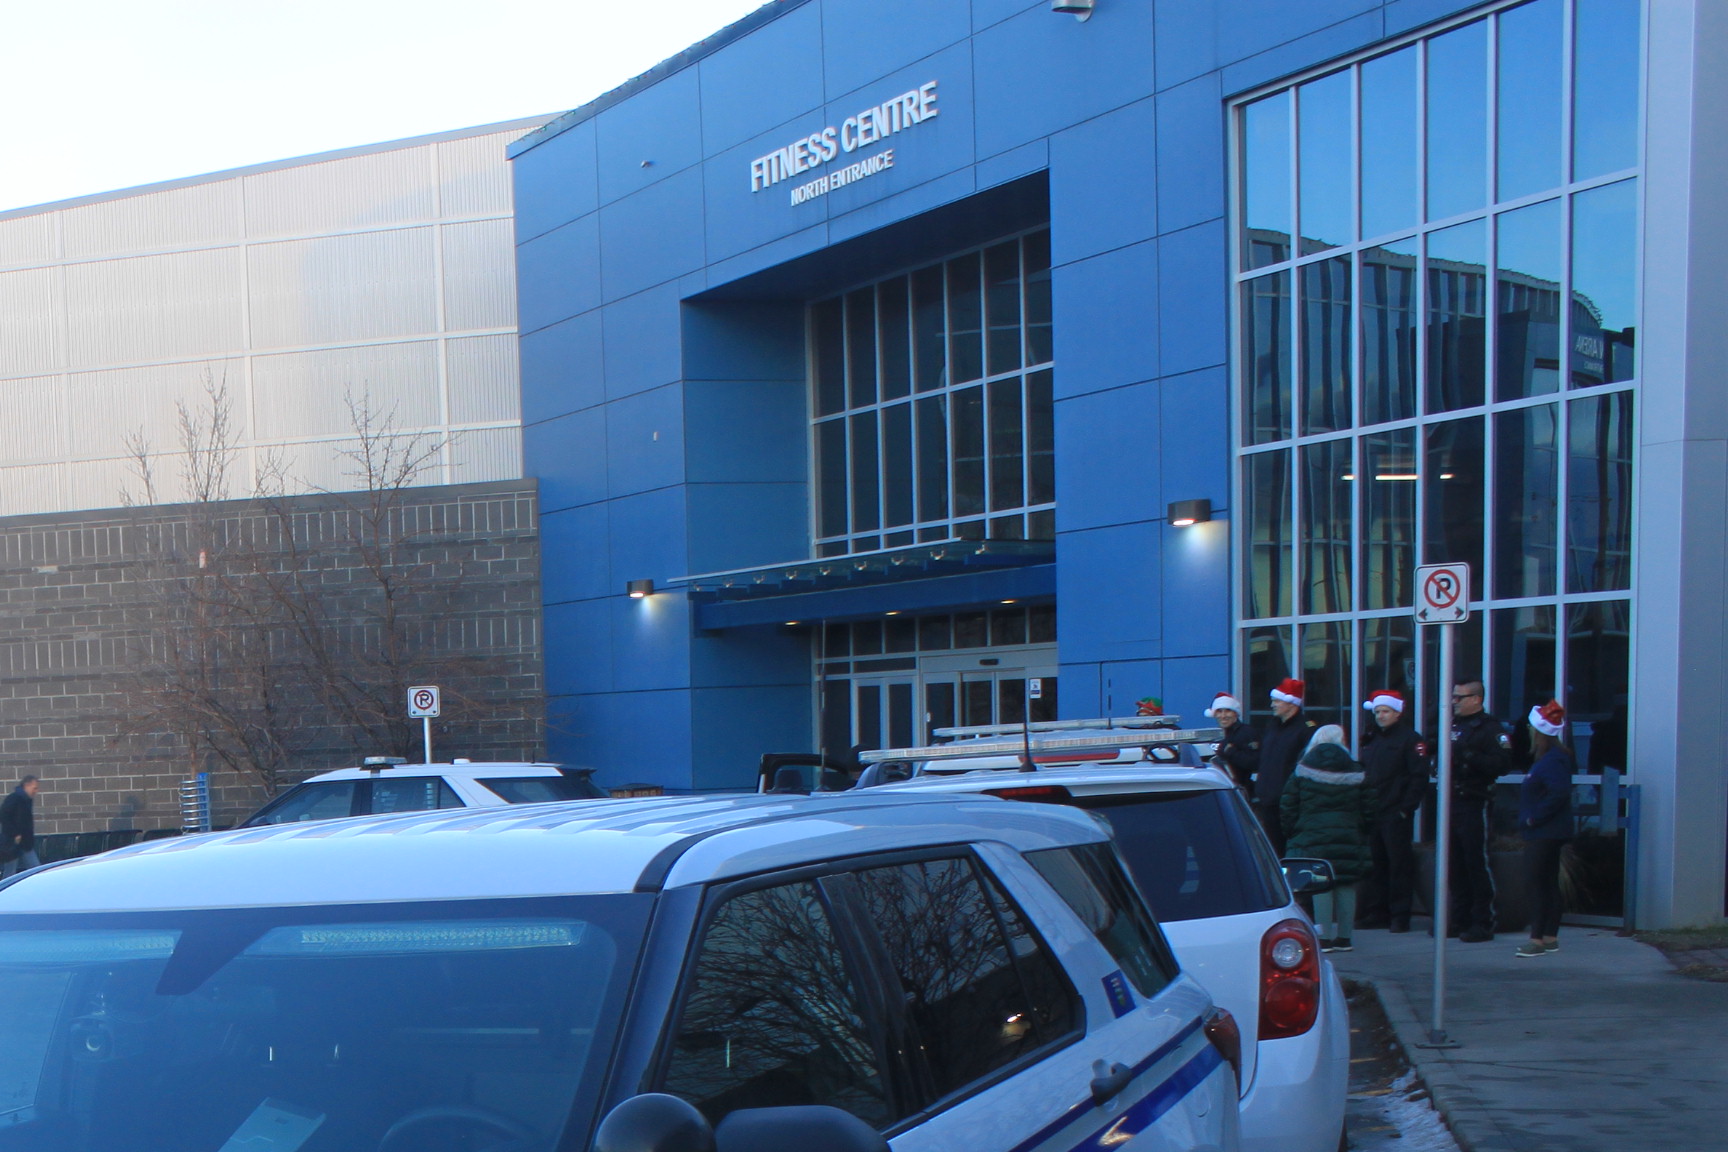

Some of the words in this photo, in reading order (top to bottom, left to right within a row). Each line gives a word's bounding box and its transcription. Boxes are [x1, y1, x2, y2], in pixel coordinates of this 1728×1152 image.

[750, 126, 838, 193] FITNESS
[841, 80, 939, 153] CENTRE
[790, 175, 828, 207] NORTH
[829, 149, 895, 191] ENTRANCE
